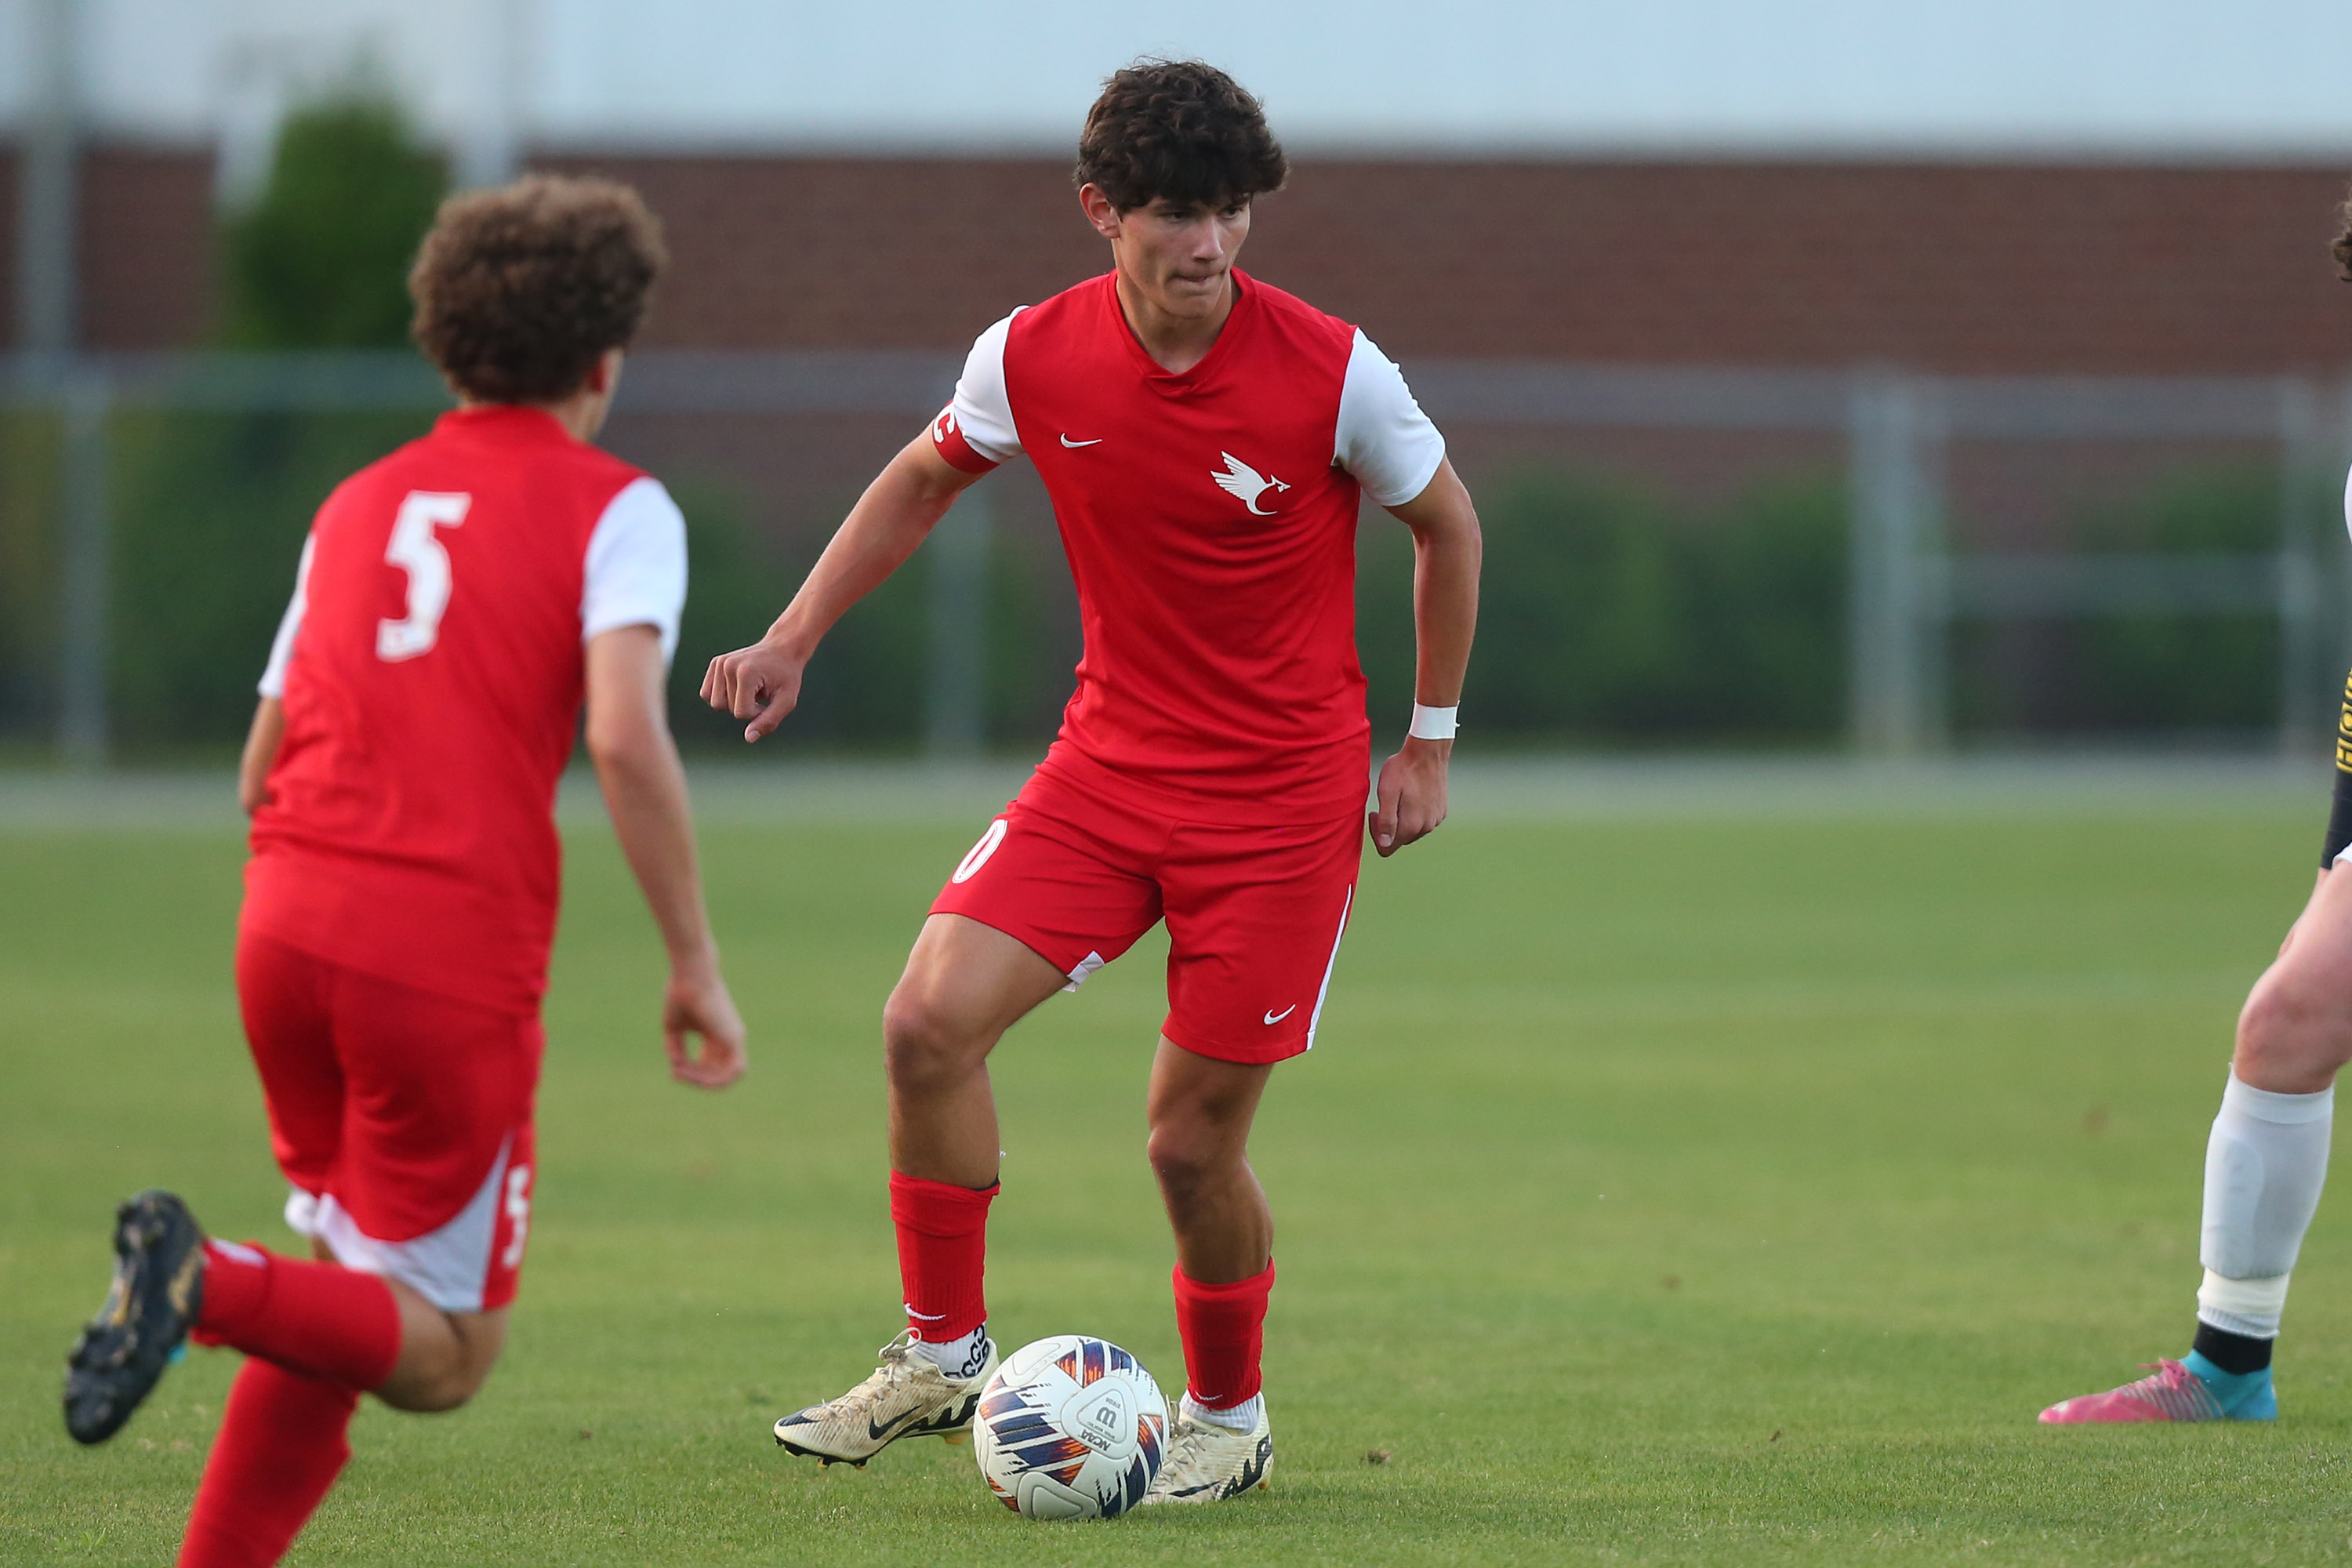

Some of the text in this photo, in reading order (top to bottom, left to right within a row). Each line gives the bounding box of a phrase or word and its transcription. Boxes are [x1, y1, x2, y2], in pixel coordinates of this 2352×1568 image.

[933, 401, 956, 444] C
[376, 489, 473, 663] 5
[952, 818, 1008, 884] 0
[502, 1166, 531, 1268] 5
[1081, 1428, 1112, 1451] NCAA
